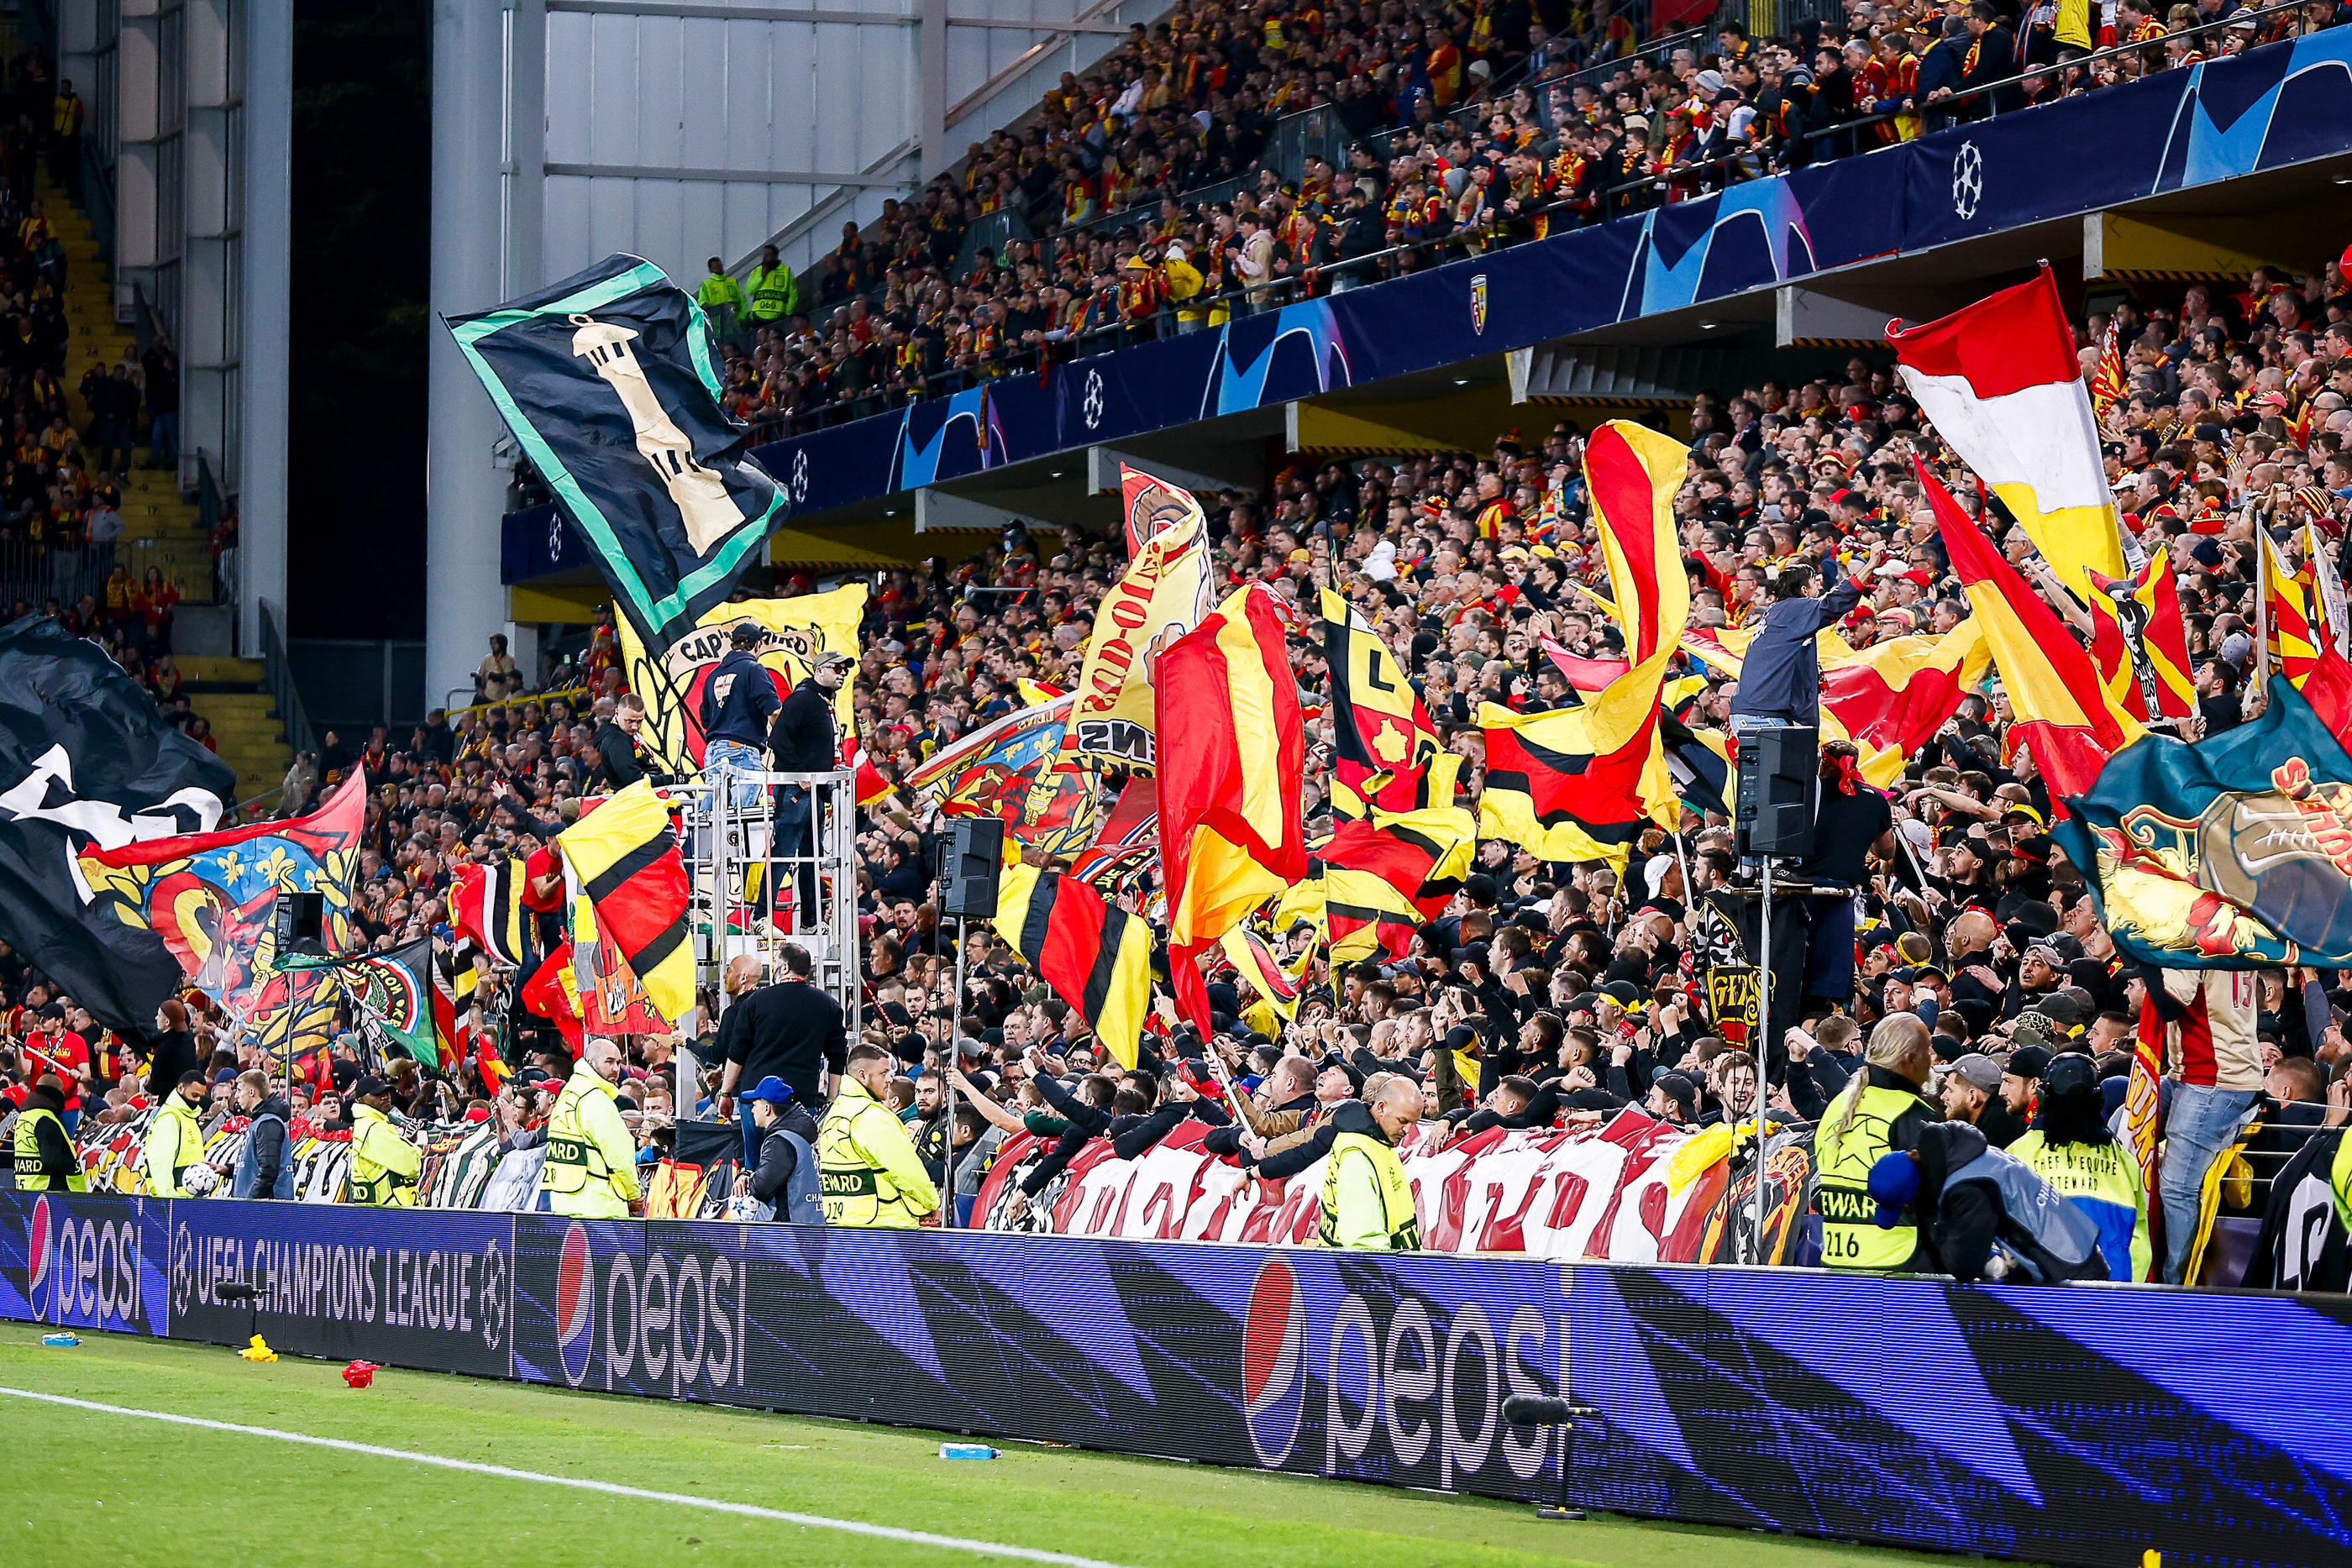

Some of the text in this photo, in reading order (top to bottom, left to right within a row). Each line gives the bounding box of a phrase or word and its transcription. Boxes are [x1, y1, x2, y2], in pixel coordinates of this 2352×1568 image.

[2034, 1156, 2060, 1172] CHEF
[2050, 1176, 2098, 1192] STEWARD
[57, 1198, 144, 1329] pepsi
[197, 1235, 473, 1332] UEFA CHAMPIONS LEAGUE
[1827, 1230, 1860, 1258] 216
[605, 1225, 748, 1396] pepsi
[1325, 1266, 1575, 1489] pepsi
